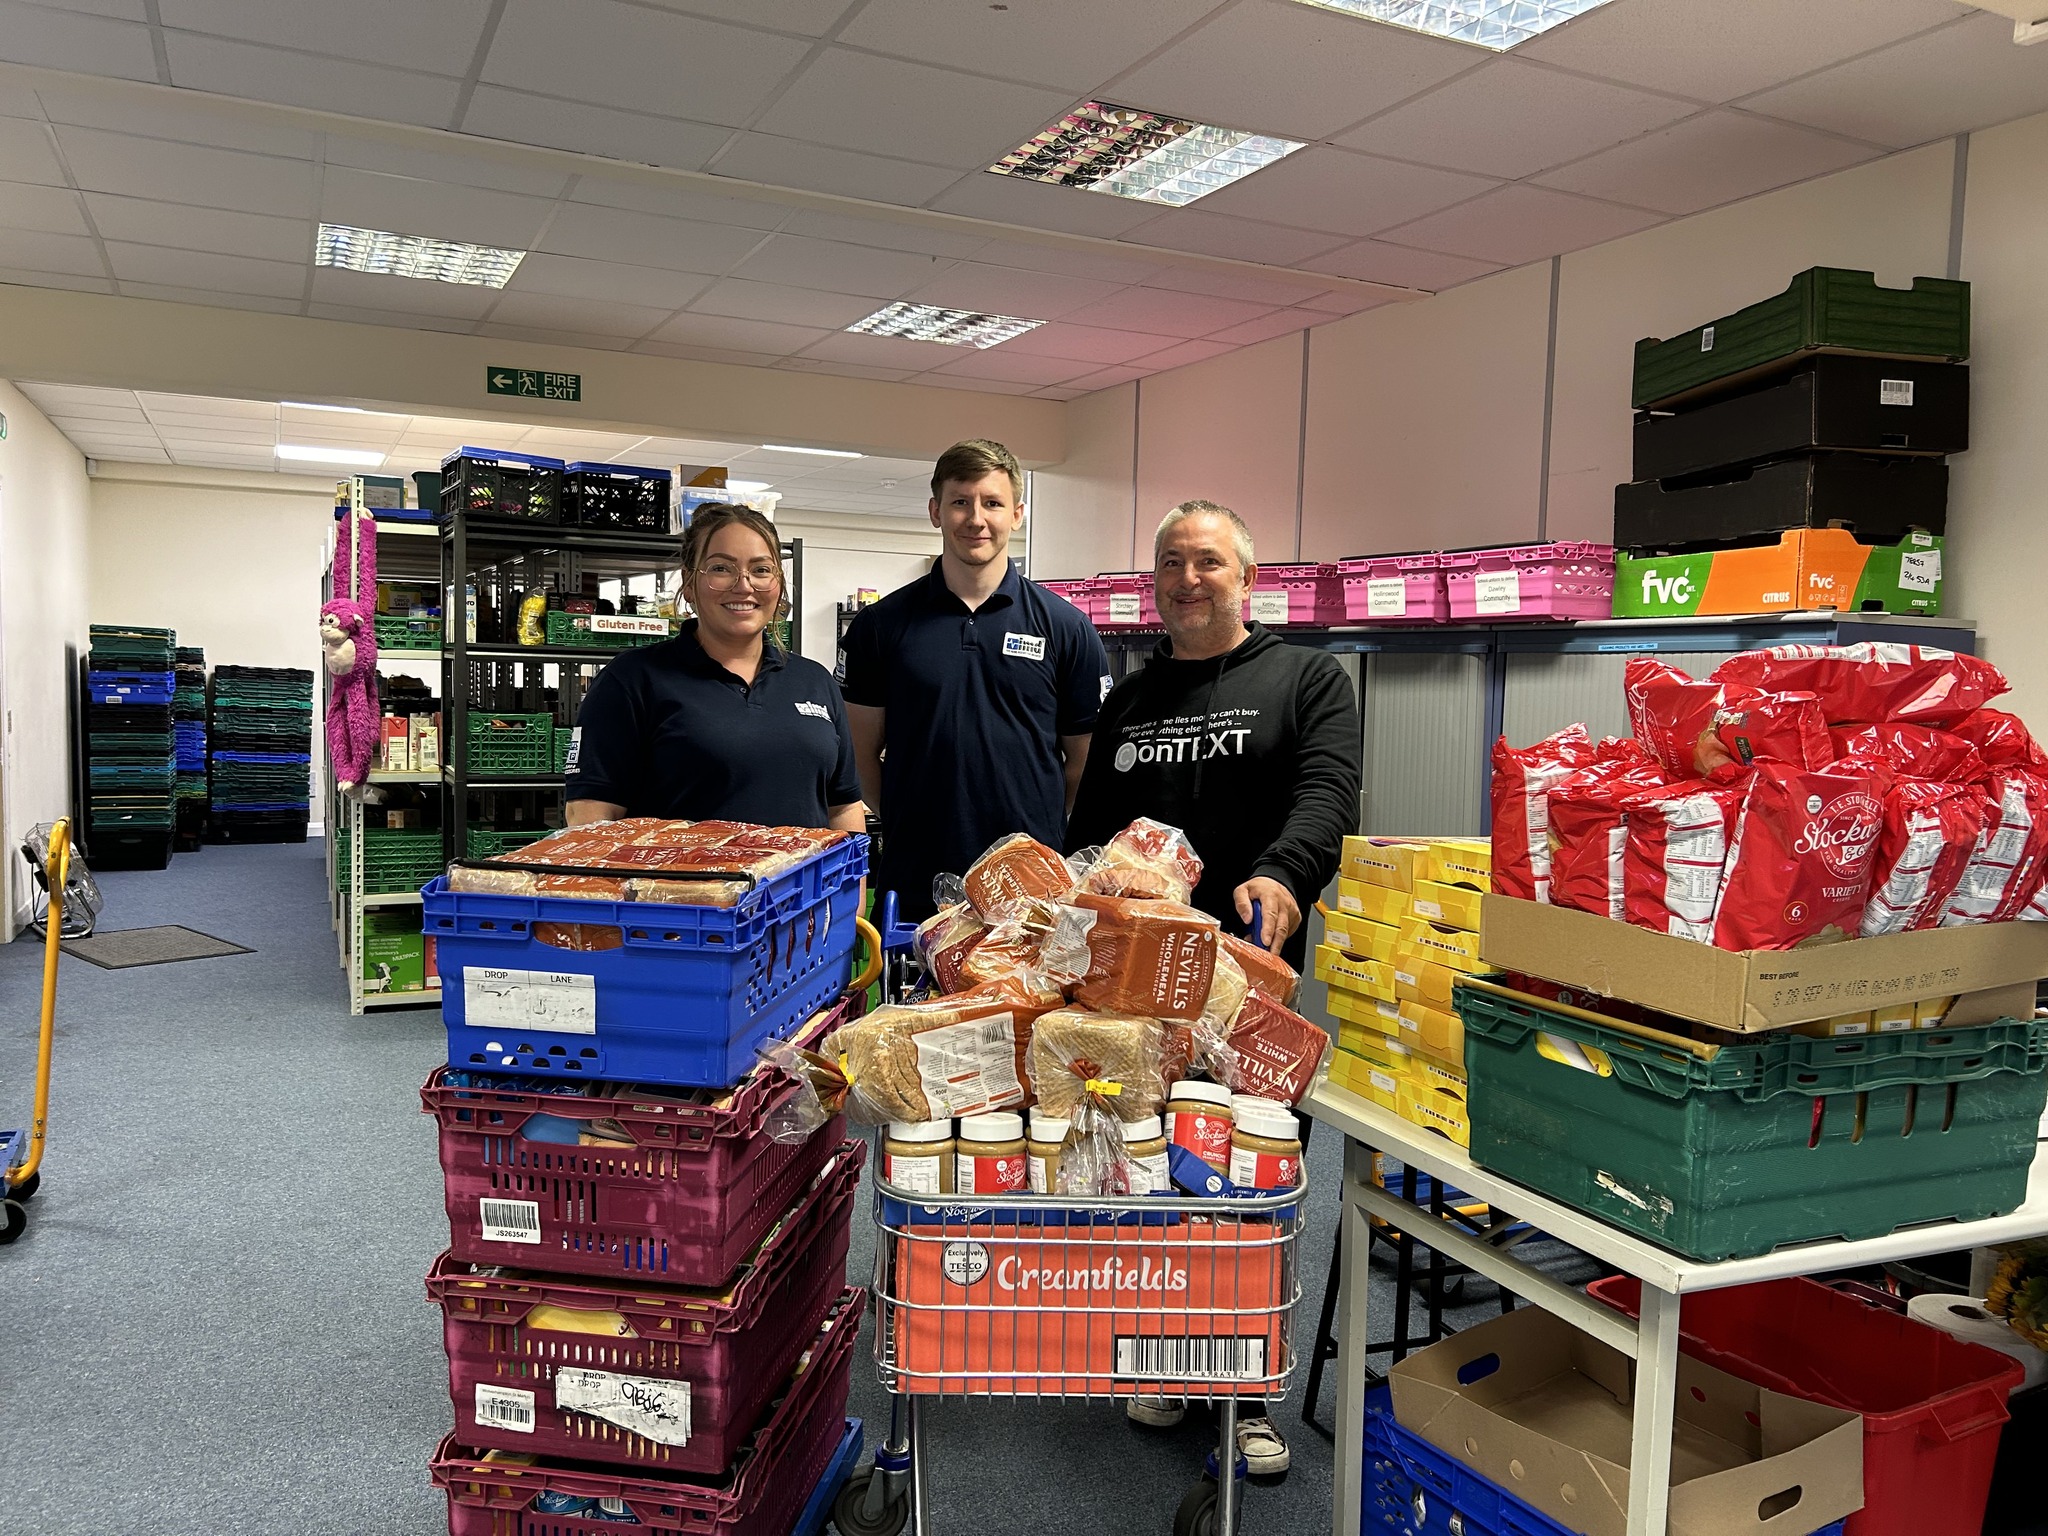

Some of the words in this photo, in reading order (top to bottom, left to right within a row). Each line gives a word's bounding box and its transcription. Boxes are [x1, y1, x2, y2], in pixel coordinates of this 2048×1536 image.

[544, 374, 576, 387] FIRE
[544, 386, 576, 399] EXIT
[1642, 569, 1690, 604] fvc
[1809, 573, 1834, 589] fvc
[1762, 592, 1790, 604] CITRUS
[1912, 599, 1928, 607] CITRUS
[597, 620, 635, 630] Gluten
[638, 621, 663, 632] Free
[1121, 724, 1140, 733] There
[1174, 716, 1189, 724] lies
[1218, 708, 1241, 718] can't
[1241, 708, 1260, 717] buy.
[1128, 731, 1141, 739] For
[1185, 725, 1202, 734] else
[1822, 884, 1862, 898] VARIETY
[1791, 905, 1801, 918] 6
[392, 951, 420, 962] MULTIPACK
[1156, 932, 1176, 1004] WHOLEMEAL
[1173, 931, 1200, 1010] NEVILL'S
[1191, 961, 1201, 983] H.W.
[484, 970, 509, 979] DROP
[550, 975, 573, 984] LANE
[1778, 971, 1800, 980] BEFORE
[1802, 984, 1823, 1003] SEP
[1255, 1042, 1288, 1064] WHITE
[1201, 1150, 1226, 1159] CRUNCHY
[495, 1230, 528, 1238] JS263547
[949, 1262, 982, 1270] TESCO
[997, 1254, 1187, 1291] Creamfields
[578, 1380, 601, 1389] DROP
